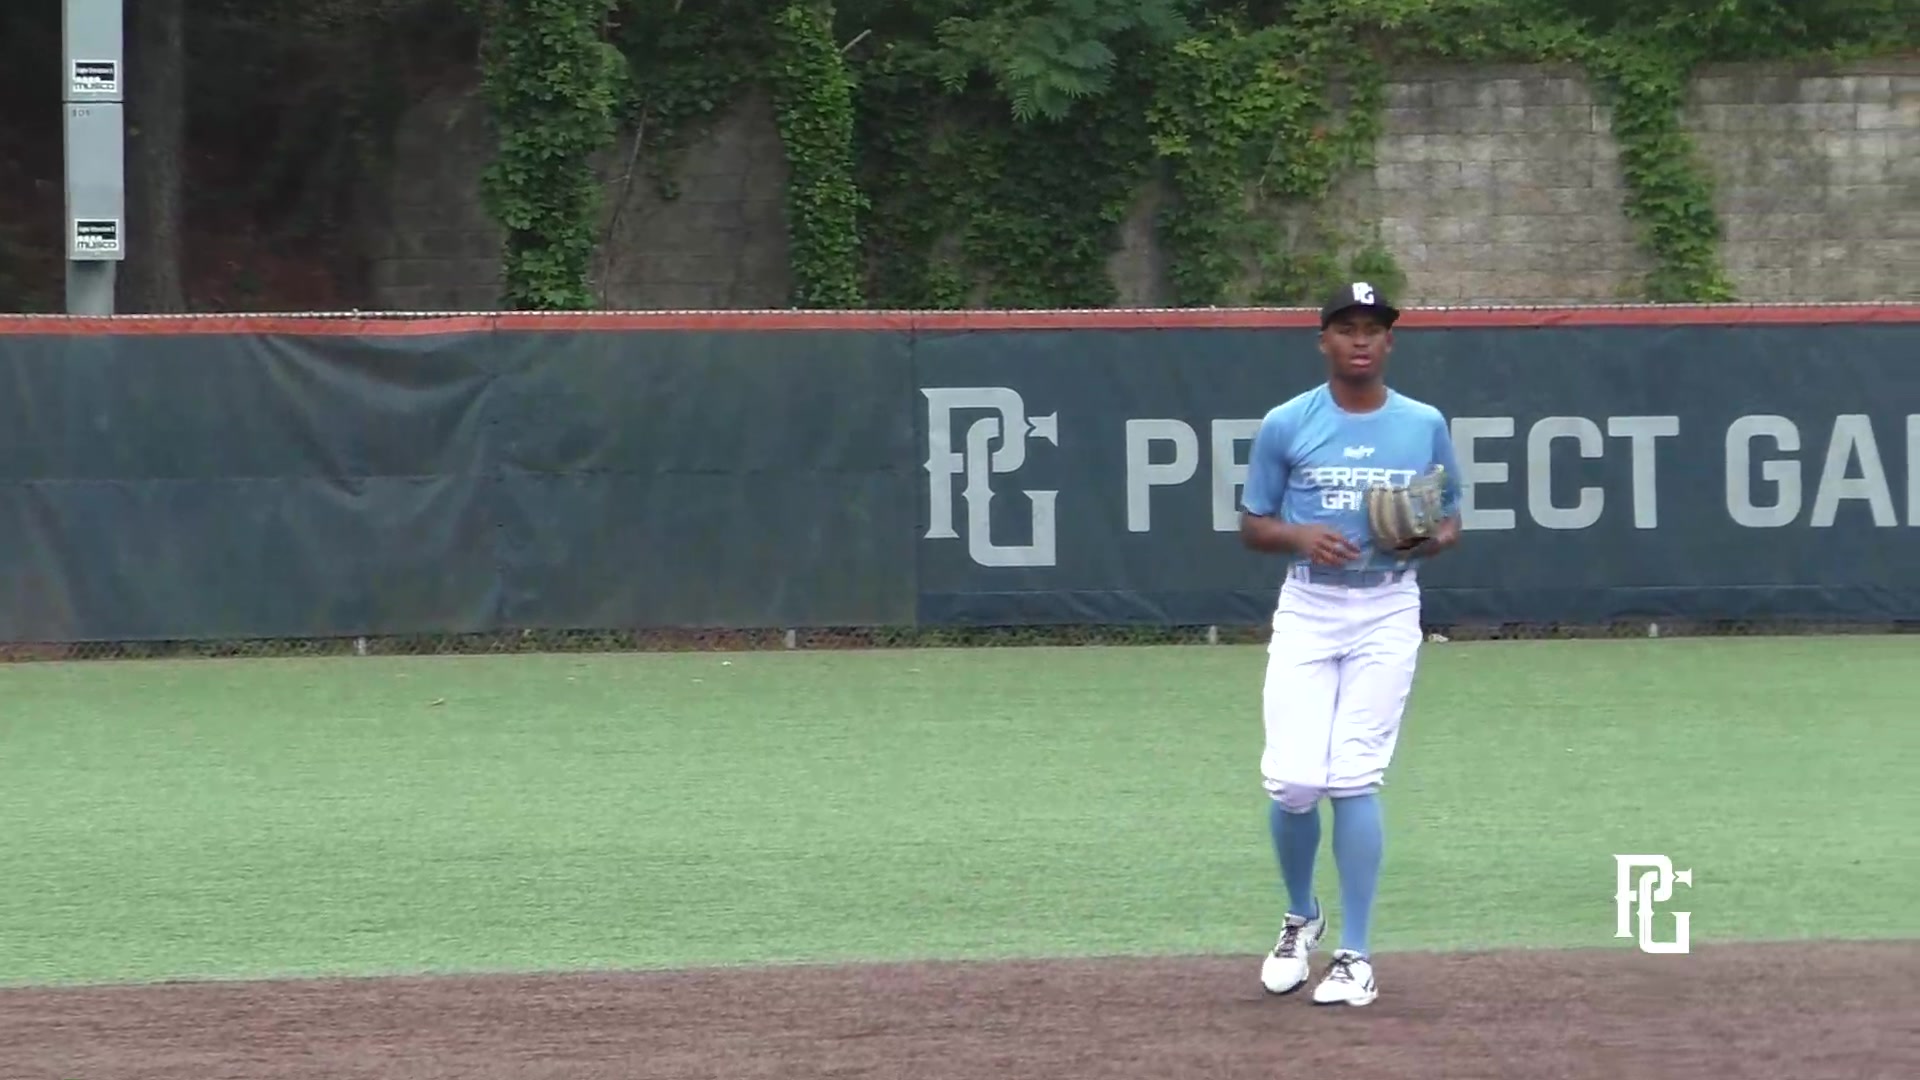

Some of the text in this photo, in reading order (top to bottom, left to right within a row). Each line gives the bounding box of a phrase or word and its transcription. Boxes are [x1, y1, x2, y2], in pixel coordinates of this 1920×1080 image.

[1352, 282, 1375, 305] PG
[920, 387, 1058, 567] PG
[1126, 415, 1681, 532] PEECT
